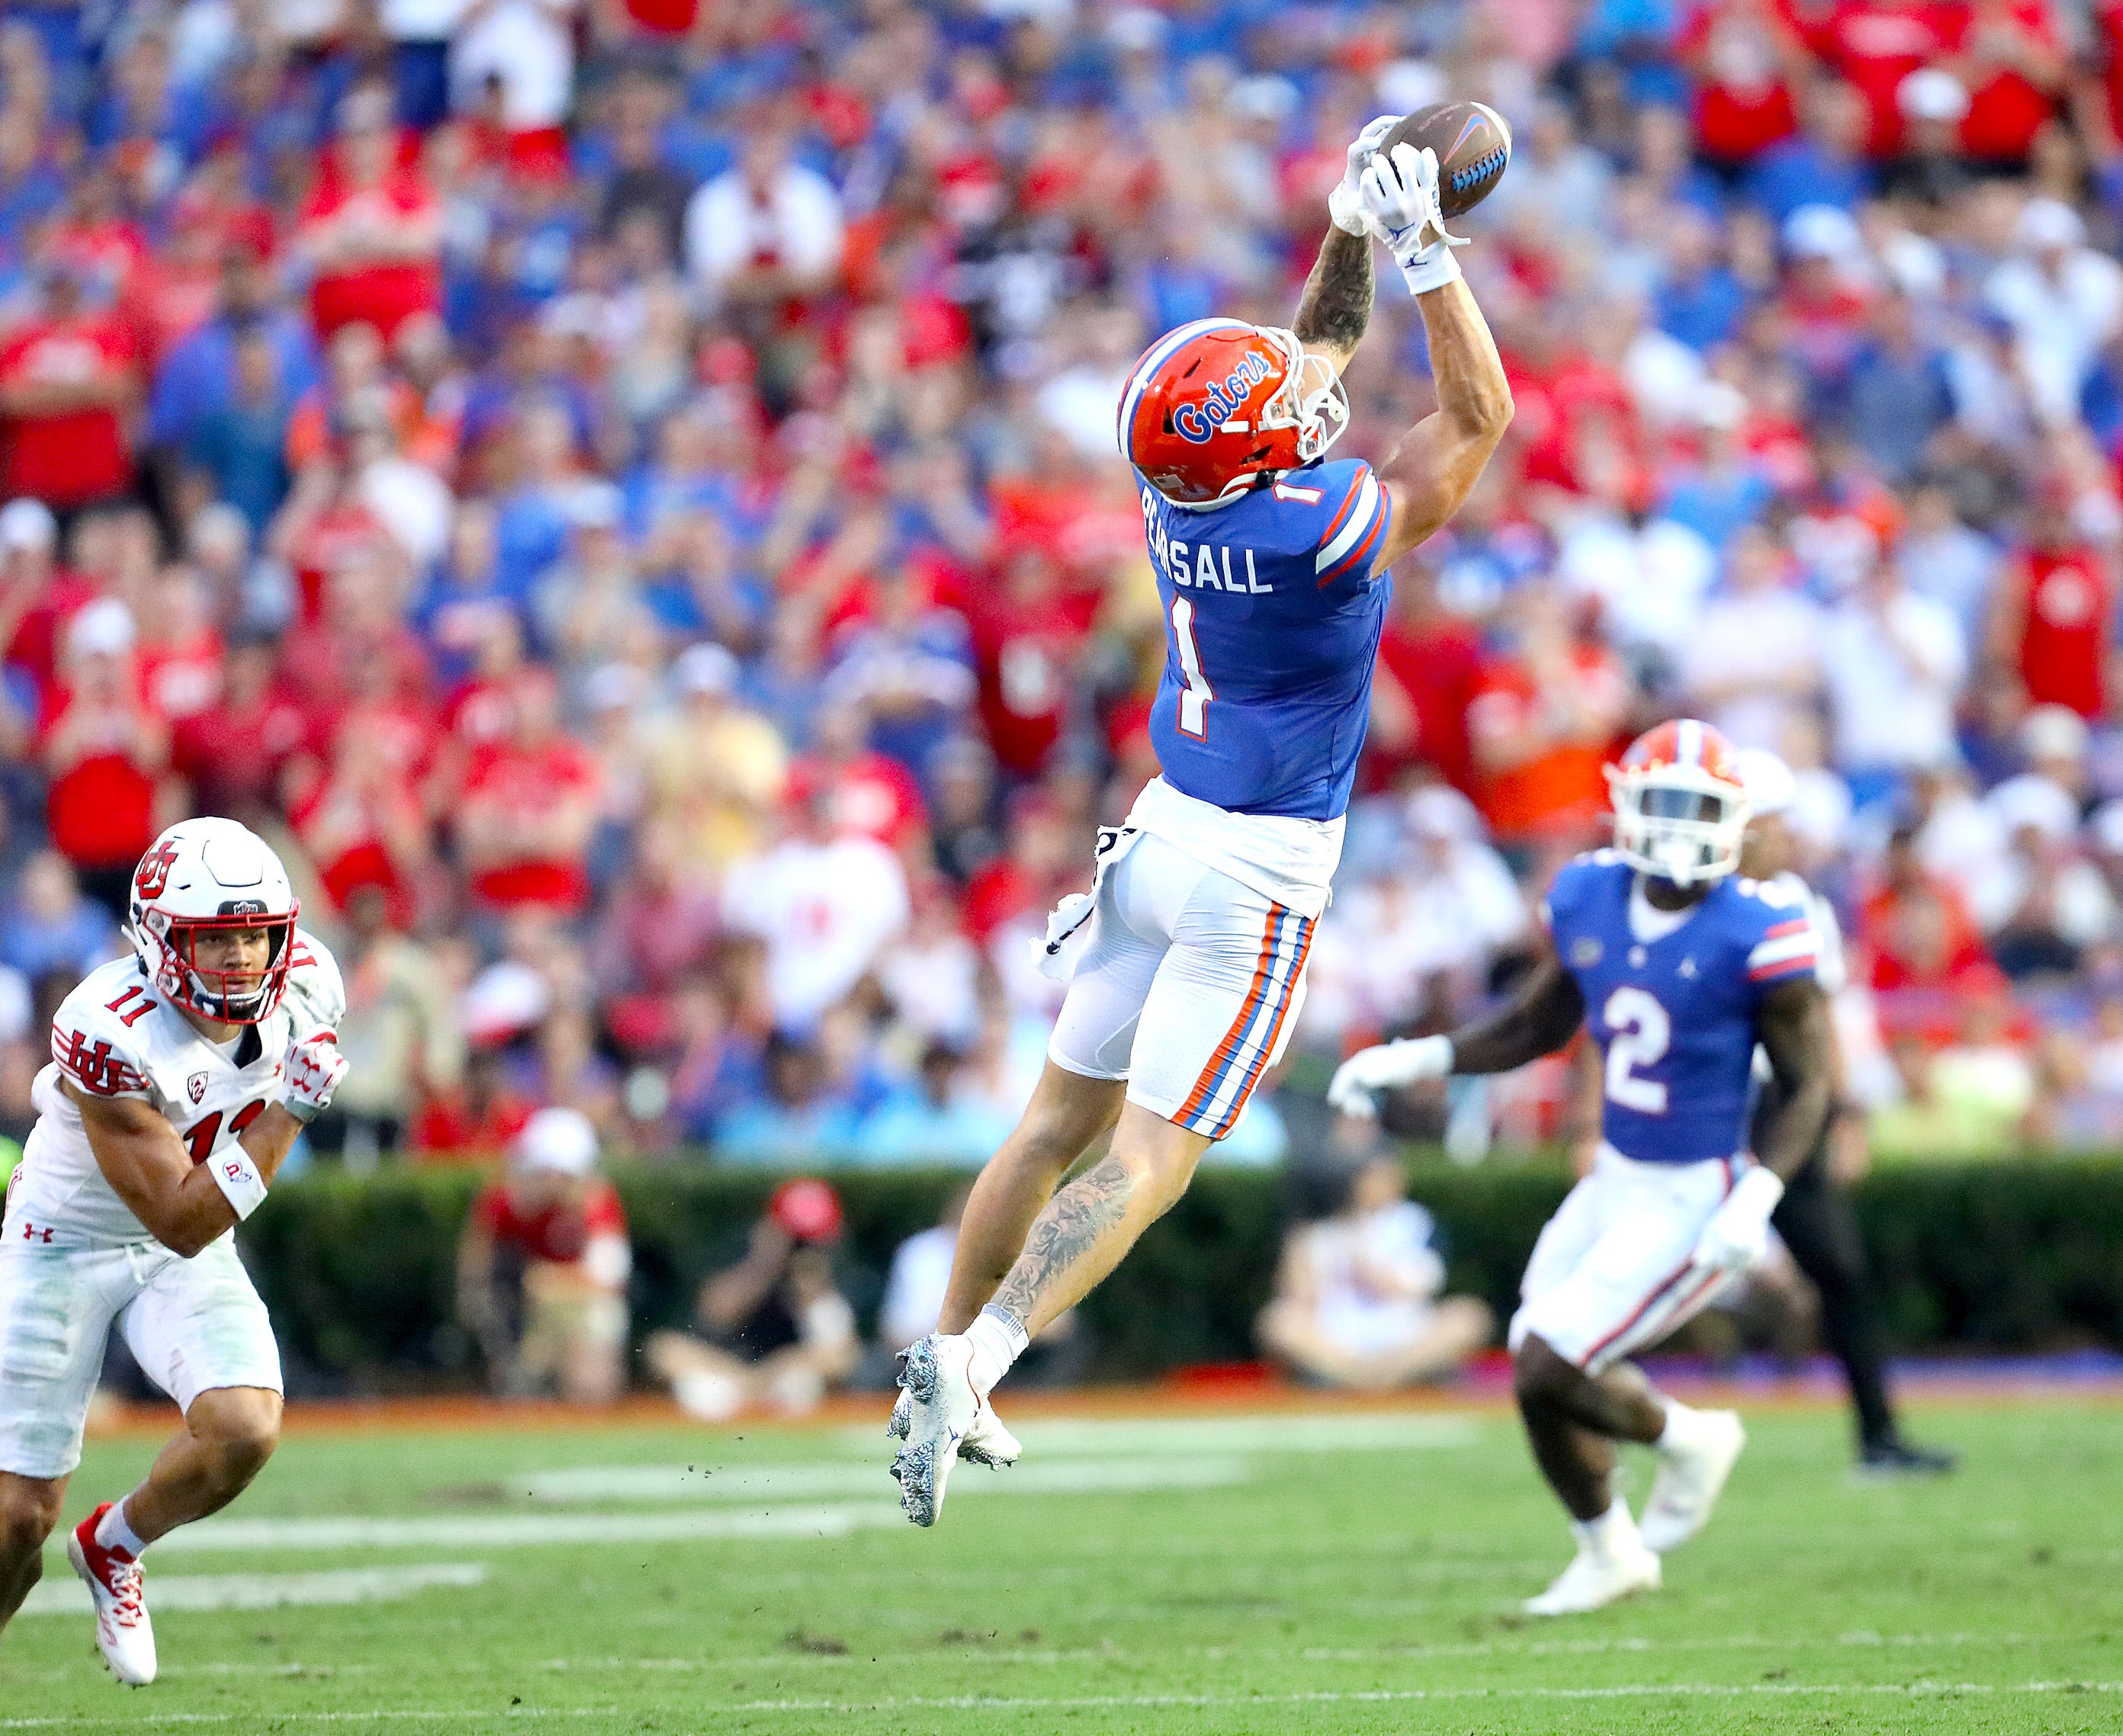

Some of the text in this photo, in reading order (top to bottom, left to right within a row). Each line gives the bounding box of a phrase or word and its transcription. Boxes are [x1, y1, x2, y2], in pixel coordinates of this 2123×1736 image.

[1174, 351, 1271, 444] Gators
[1142, 485, 1273, 594] PEARSALL
[1271, 480, 1325, 505] 1
[1171, 590, 1218, 743] 1
[104, 986, 158, 1027] 11
[1604, 987, 1670, 1113] 2
